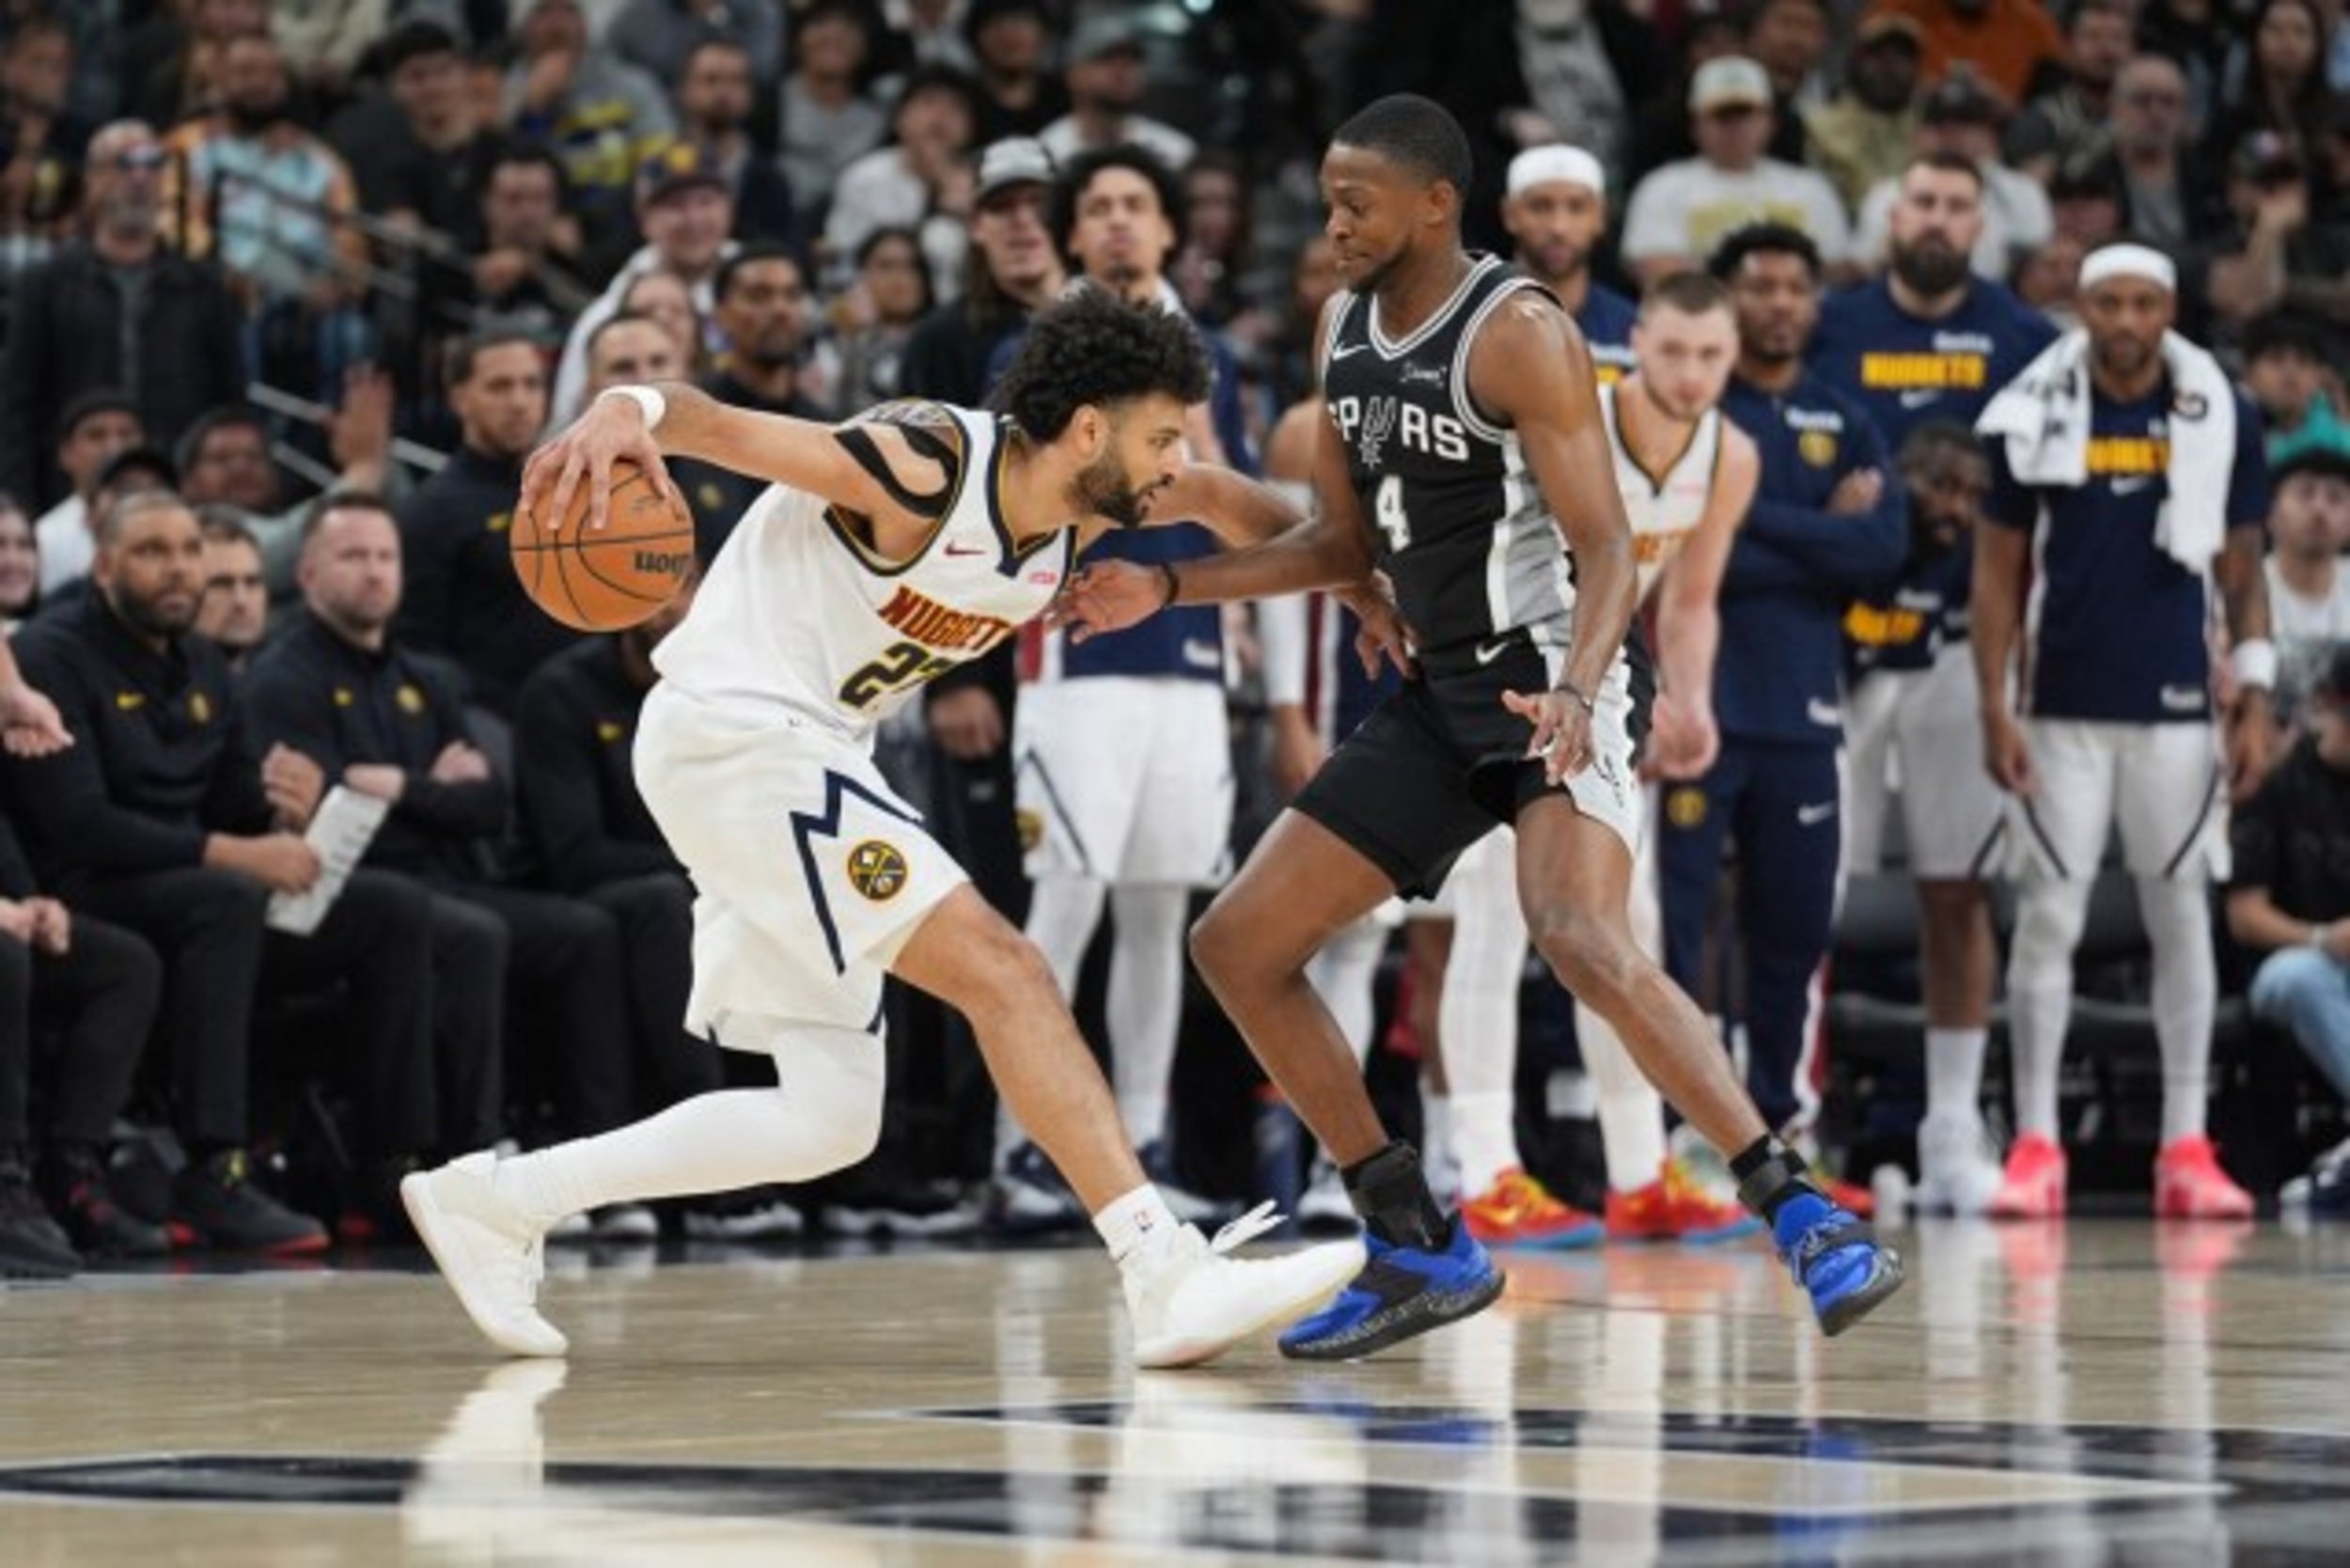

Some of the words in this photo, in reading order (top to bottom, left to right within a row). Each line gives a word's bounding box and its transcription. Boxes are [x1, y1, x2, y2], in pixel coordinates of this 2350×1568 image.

[1375, 474, 1412, 553] 4
[877, 584, 1011, 651] NUGGET
[839, 641, 952, 709] 2
